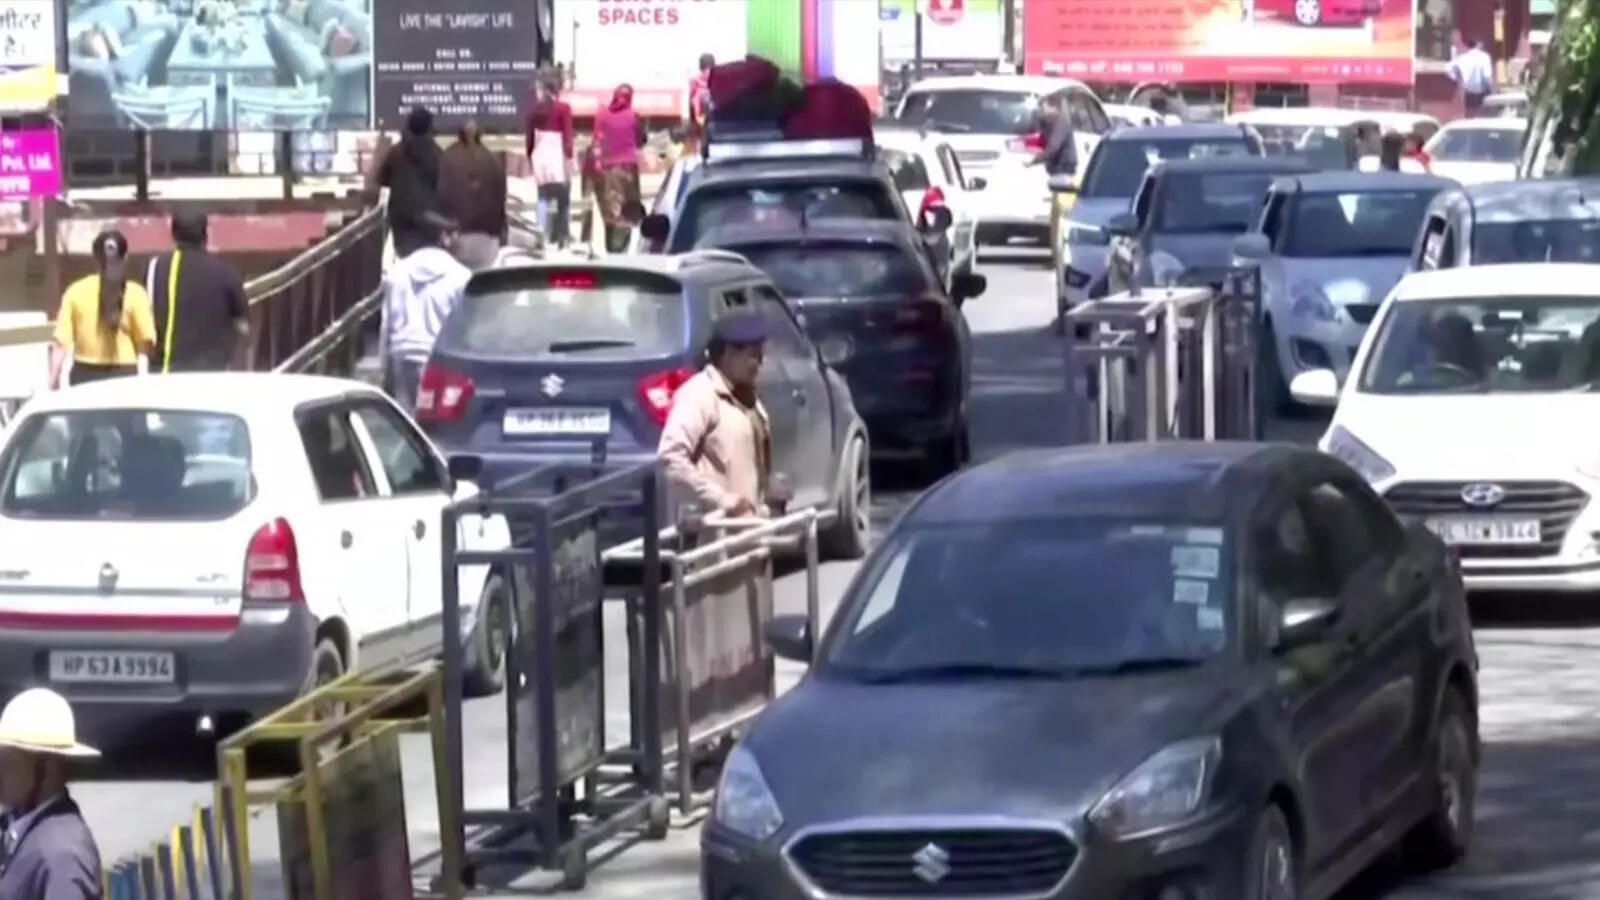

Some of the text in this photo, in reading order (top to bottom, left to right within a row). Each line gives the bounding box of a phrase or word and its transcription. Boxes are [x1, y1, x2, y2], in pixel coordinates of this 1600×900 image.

[400, 13, 421, 28] LIVE
[424, 13, 443, 28] THE
[492, 12, 513, 28] LIFE
[598, 7, 679, 25] SPACES
